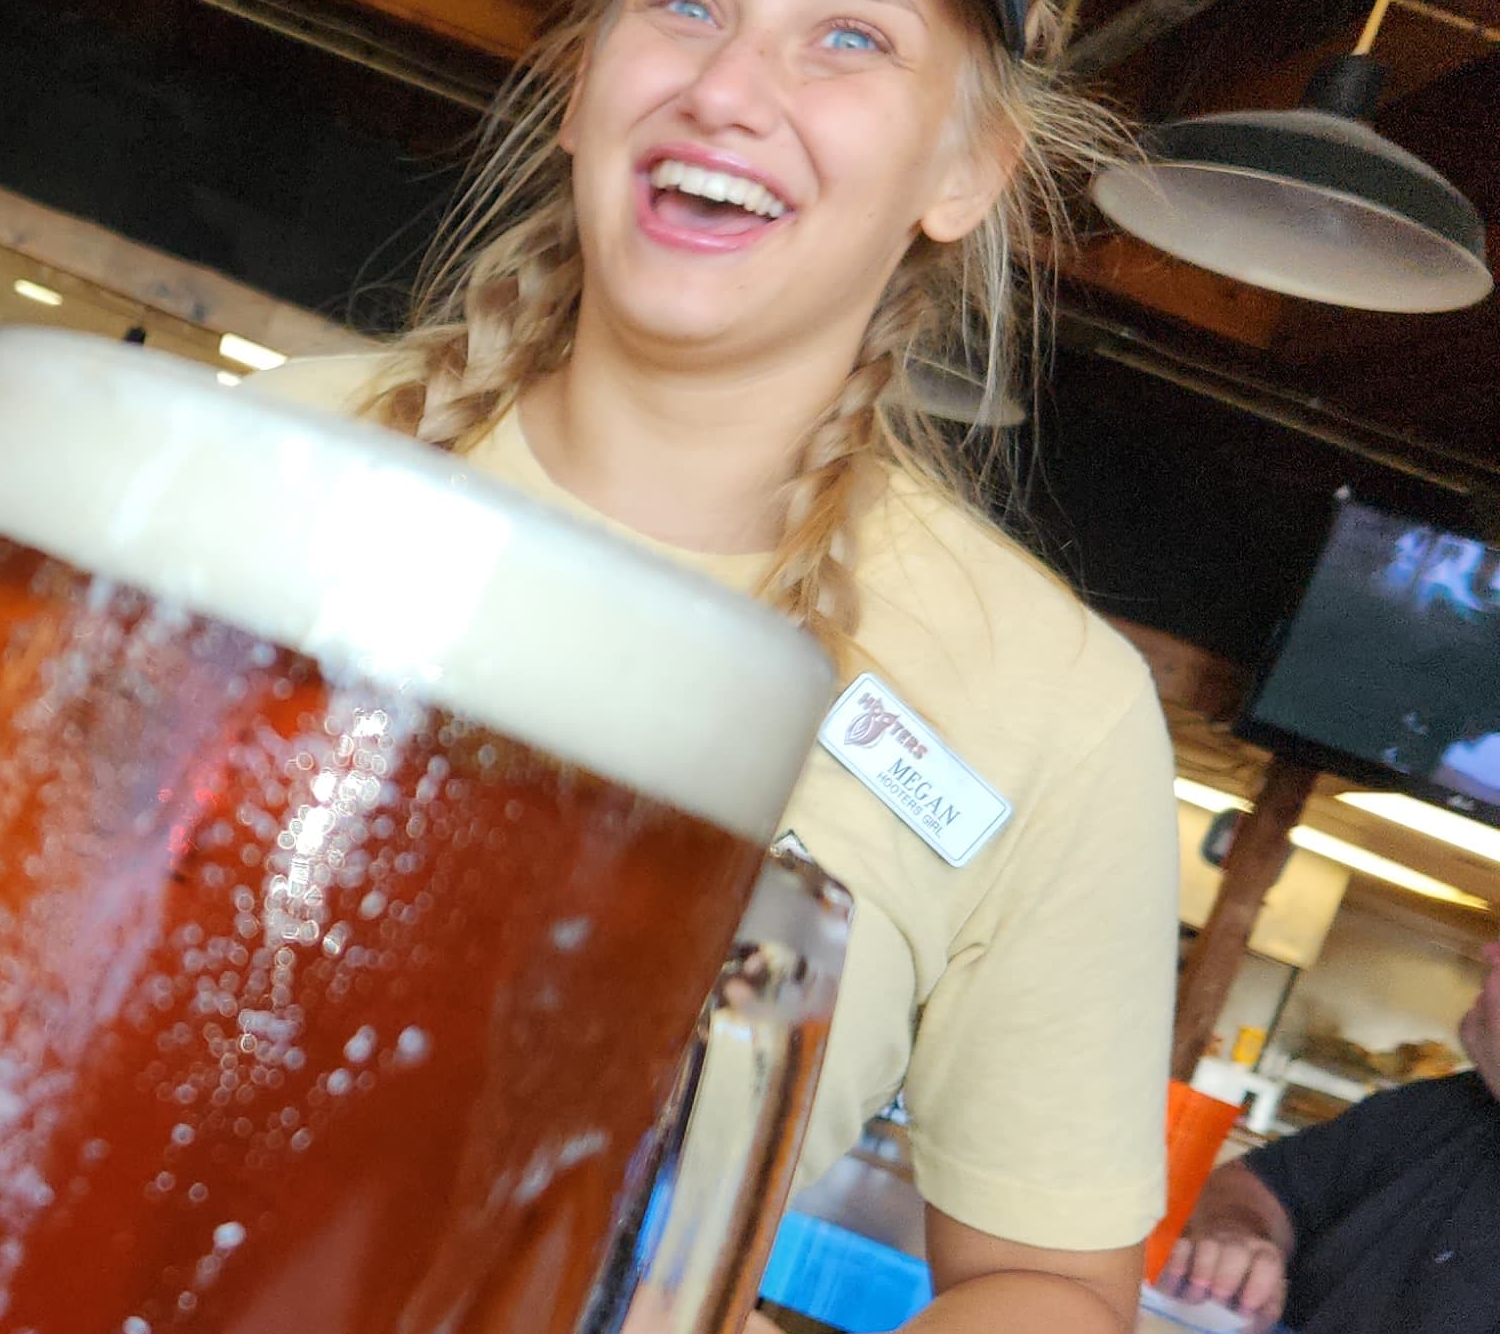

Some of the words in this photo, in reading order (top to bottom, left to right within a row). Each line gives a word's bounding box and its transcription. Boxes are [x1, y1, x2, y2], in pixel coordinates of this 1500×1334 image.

[859, 692, 928, 760] HOOTERS
[877, 771, 922, 816] HOOTERS
[922, 813, 944, 838] GIRL
[886, 757, 961, 825] MEGAN
